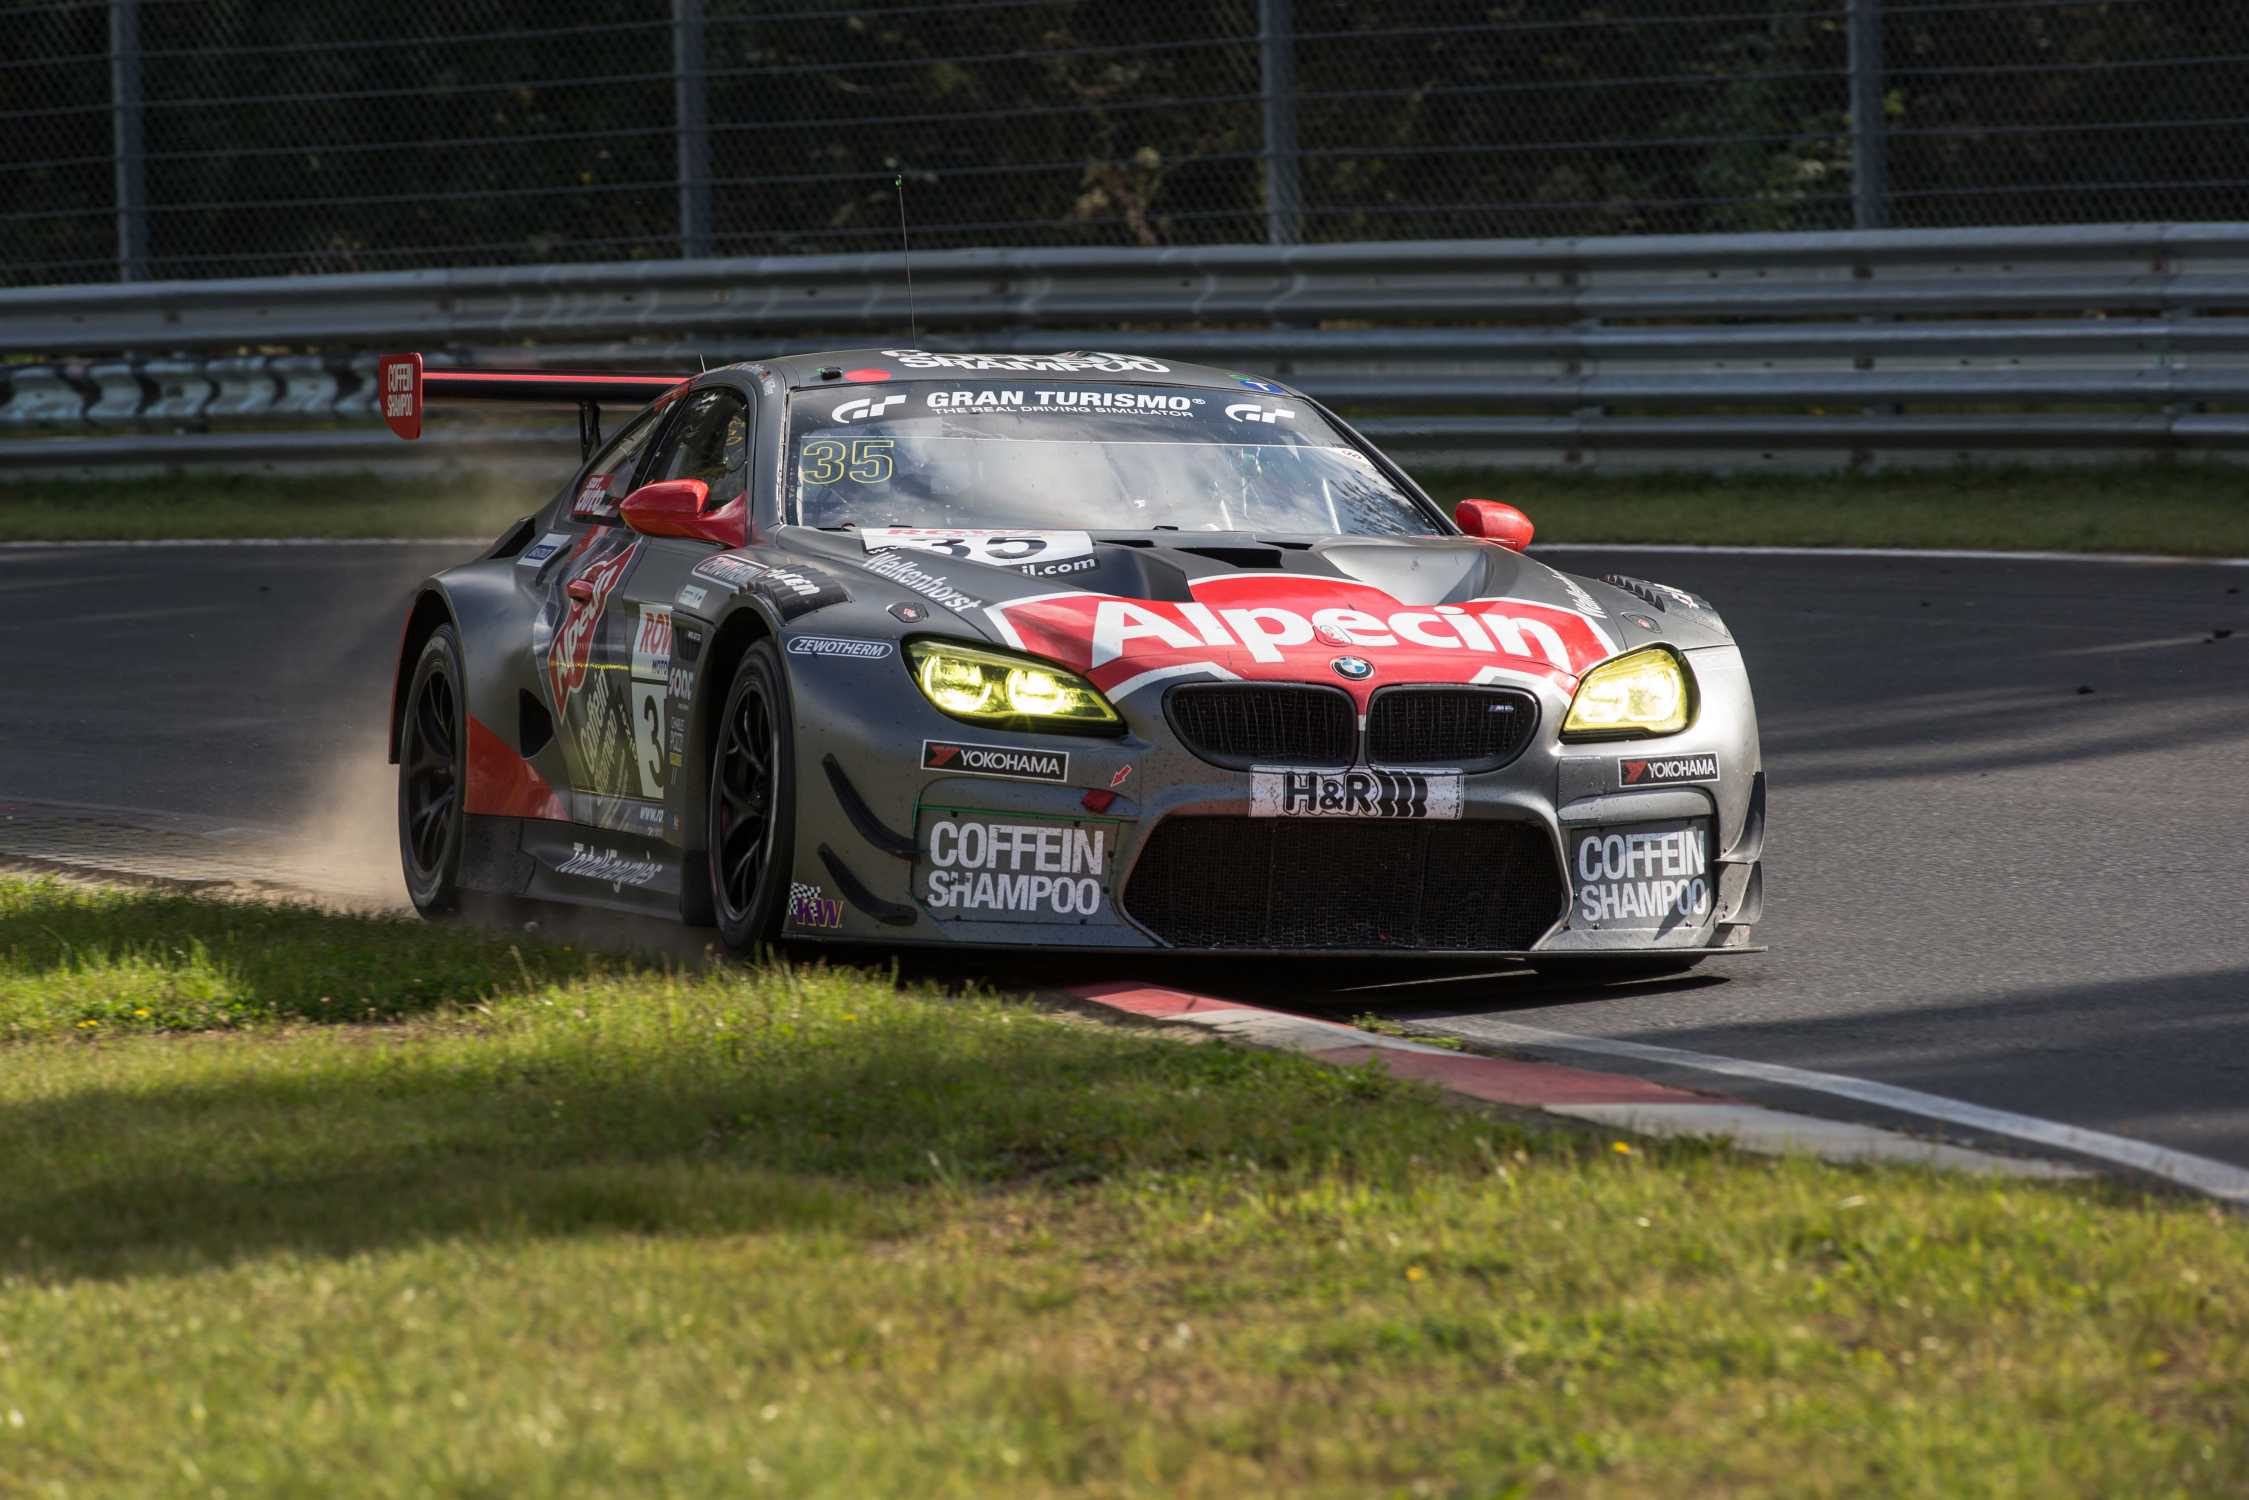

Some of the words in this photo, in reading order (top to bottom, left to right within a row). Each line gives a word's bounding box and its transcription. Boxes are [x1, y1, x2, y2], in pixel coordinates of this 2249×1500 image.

[898, 356, 1171, 373] SHAMPOO
[926, 390, 1024, 408] GRAN
[934, 407, 967, 415] THE
[968, 406, 1017, 414] REAL
[1020, 405, 1091, 414] DRIVING
[1095, 407, 1194, 418] SIMULATOR
[801, 440, 895, 485] 35
[863, 551, 983, 612] Walkenhorst
[795, 639, 886, 657] ZEWOTHERM
[1091, 601, 1573, 671] Alpecin
[960, 749, 1061, 775] YOKOHAMA
[1648, 758, 1717, 778] YOKOHAMA
[929, 821, 1105, 876] COFFEIN
[1578, 829, 1706, 882] COFFEIN
[927, 869, 1101, 916] SHAMPOO
[1580, 878, 1707, 922] SHAMPOO
